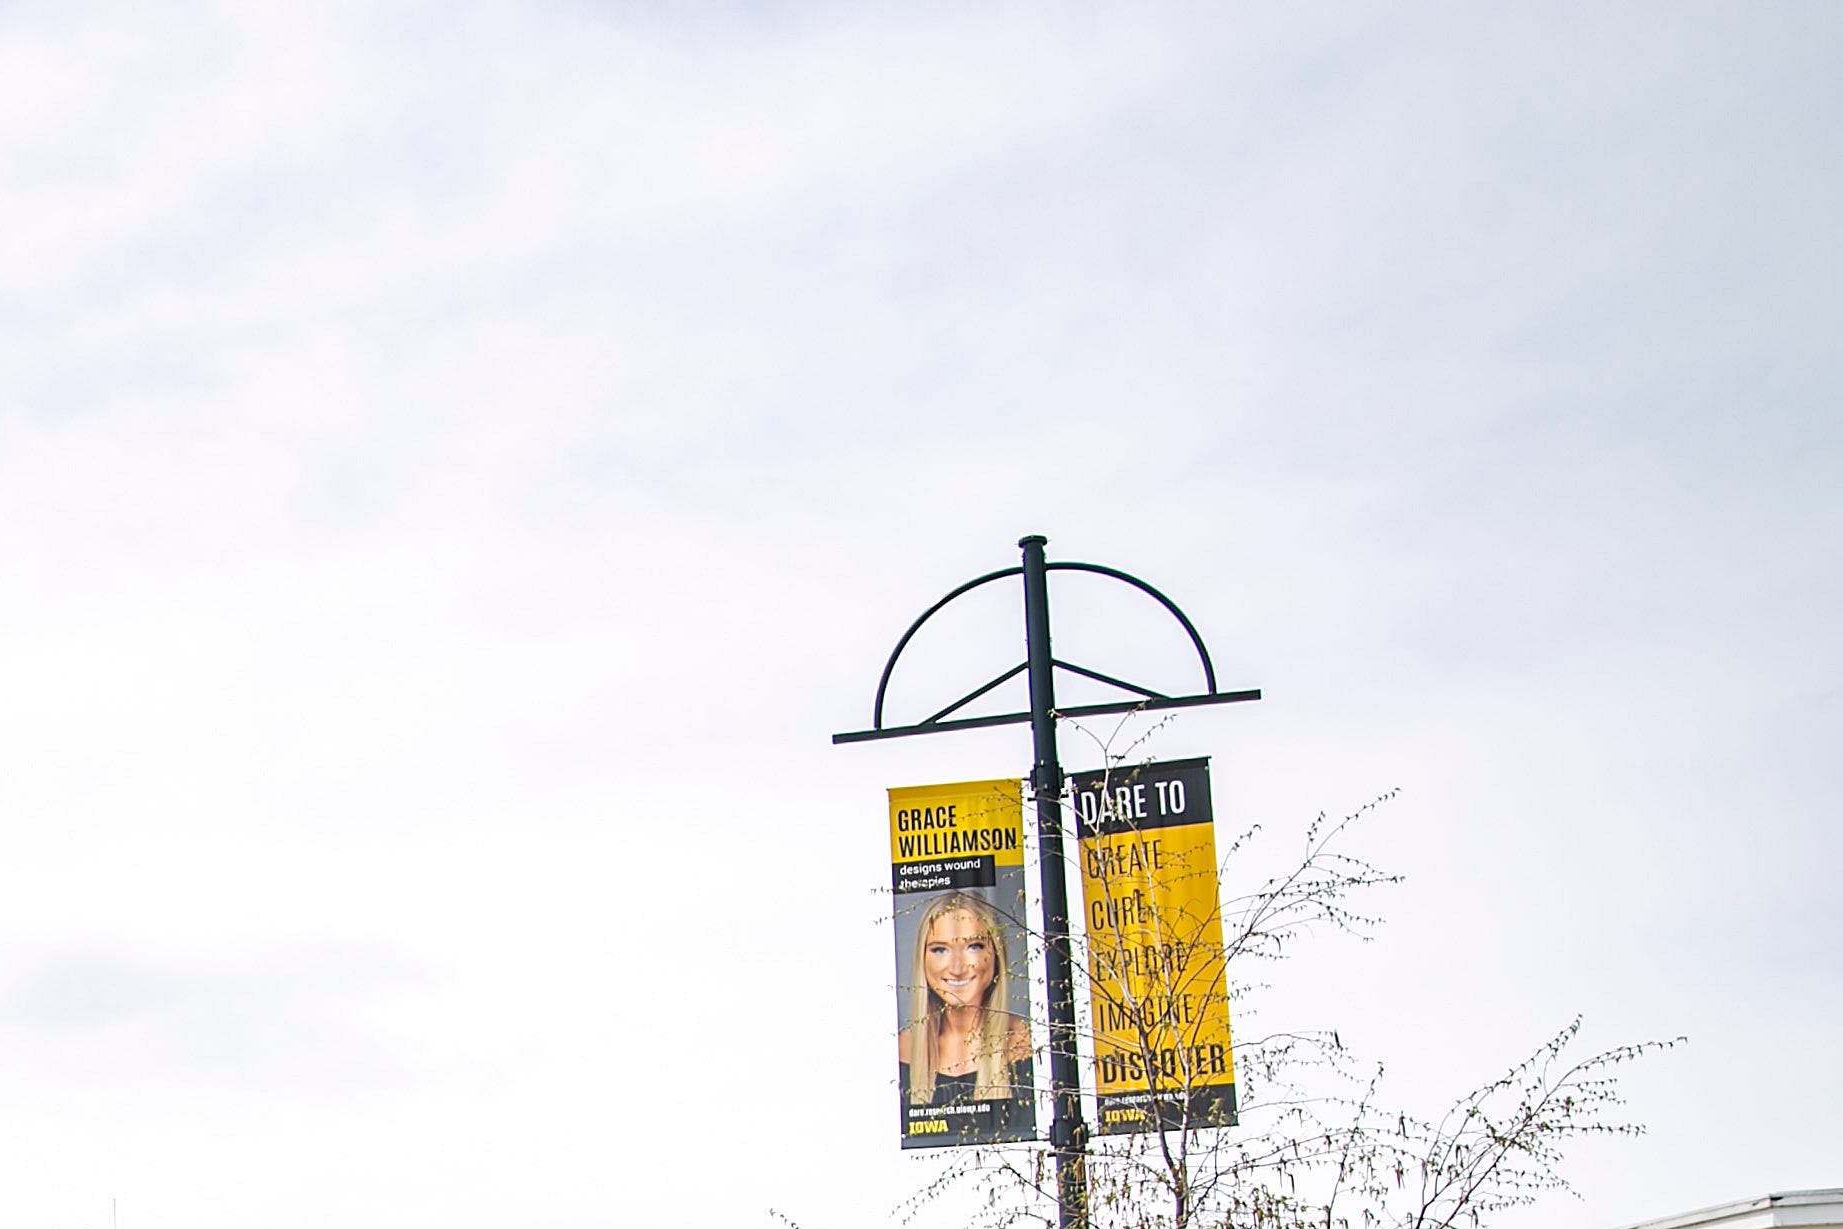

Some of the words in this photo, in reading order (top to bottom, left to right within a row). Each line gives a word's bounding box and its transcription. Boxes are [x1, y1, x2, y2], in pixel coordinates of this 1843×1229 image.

[1081, 784, 1148, 825] DARE
[1155, 779, 1186, 816] TO
[898, 805, 957, 832] GRACE
[899, 827, 1017, 858] WILLIAMSON
[900, 862, 942, 876] designs
[945, 858, 981, 872] wound
[1105, 1108, 1146, 1122] IOWA
[909, 1119, 949, 1135] IOWA
